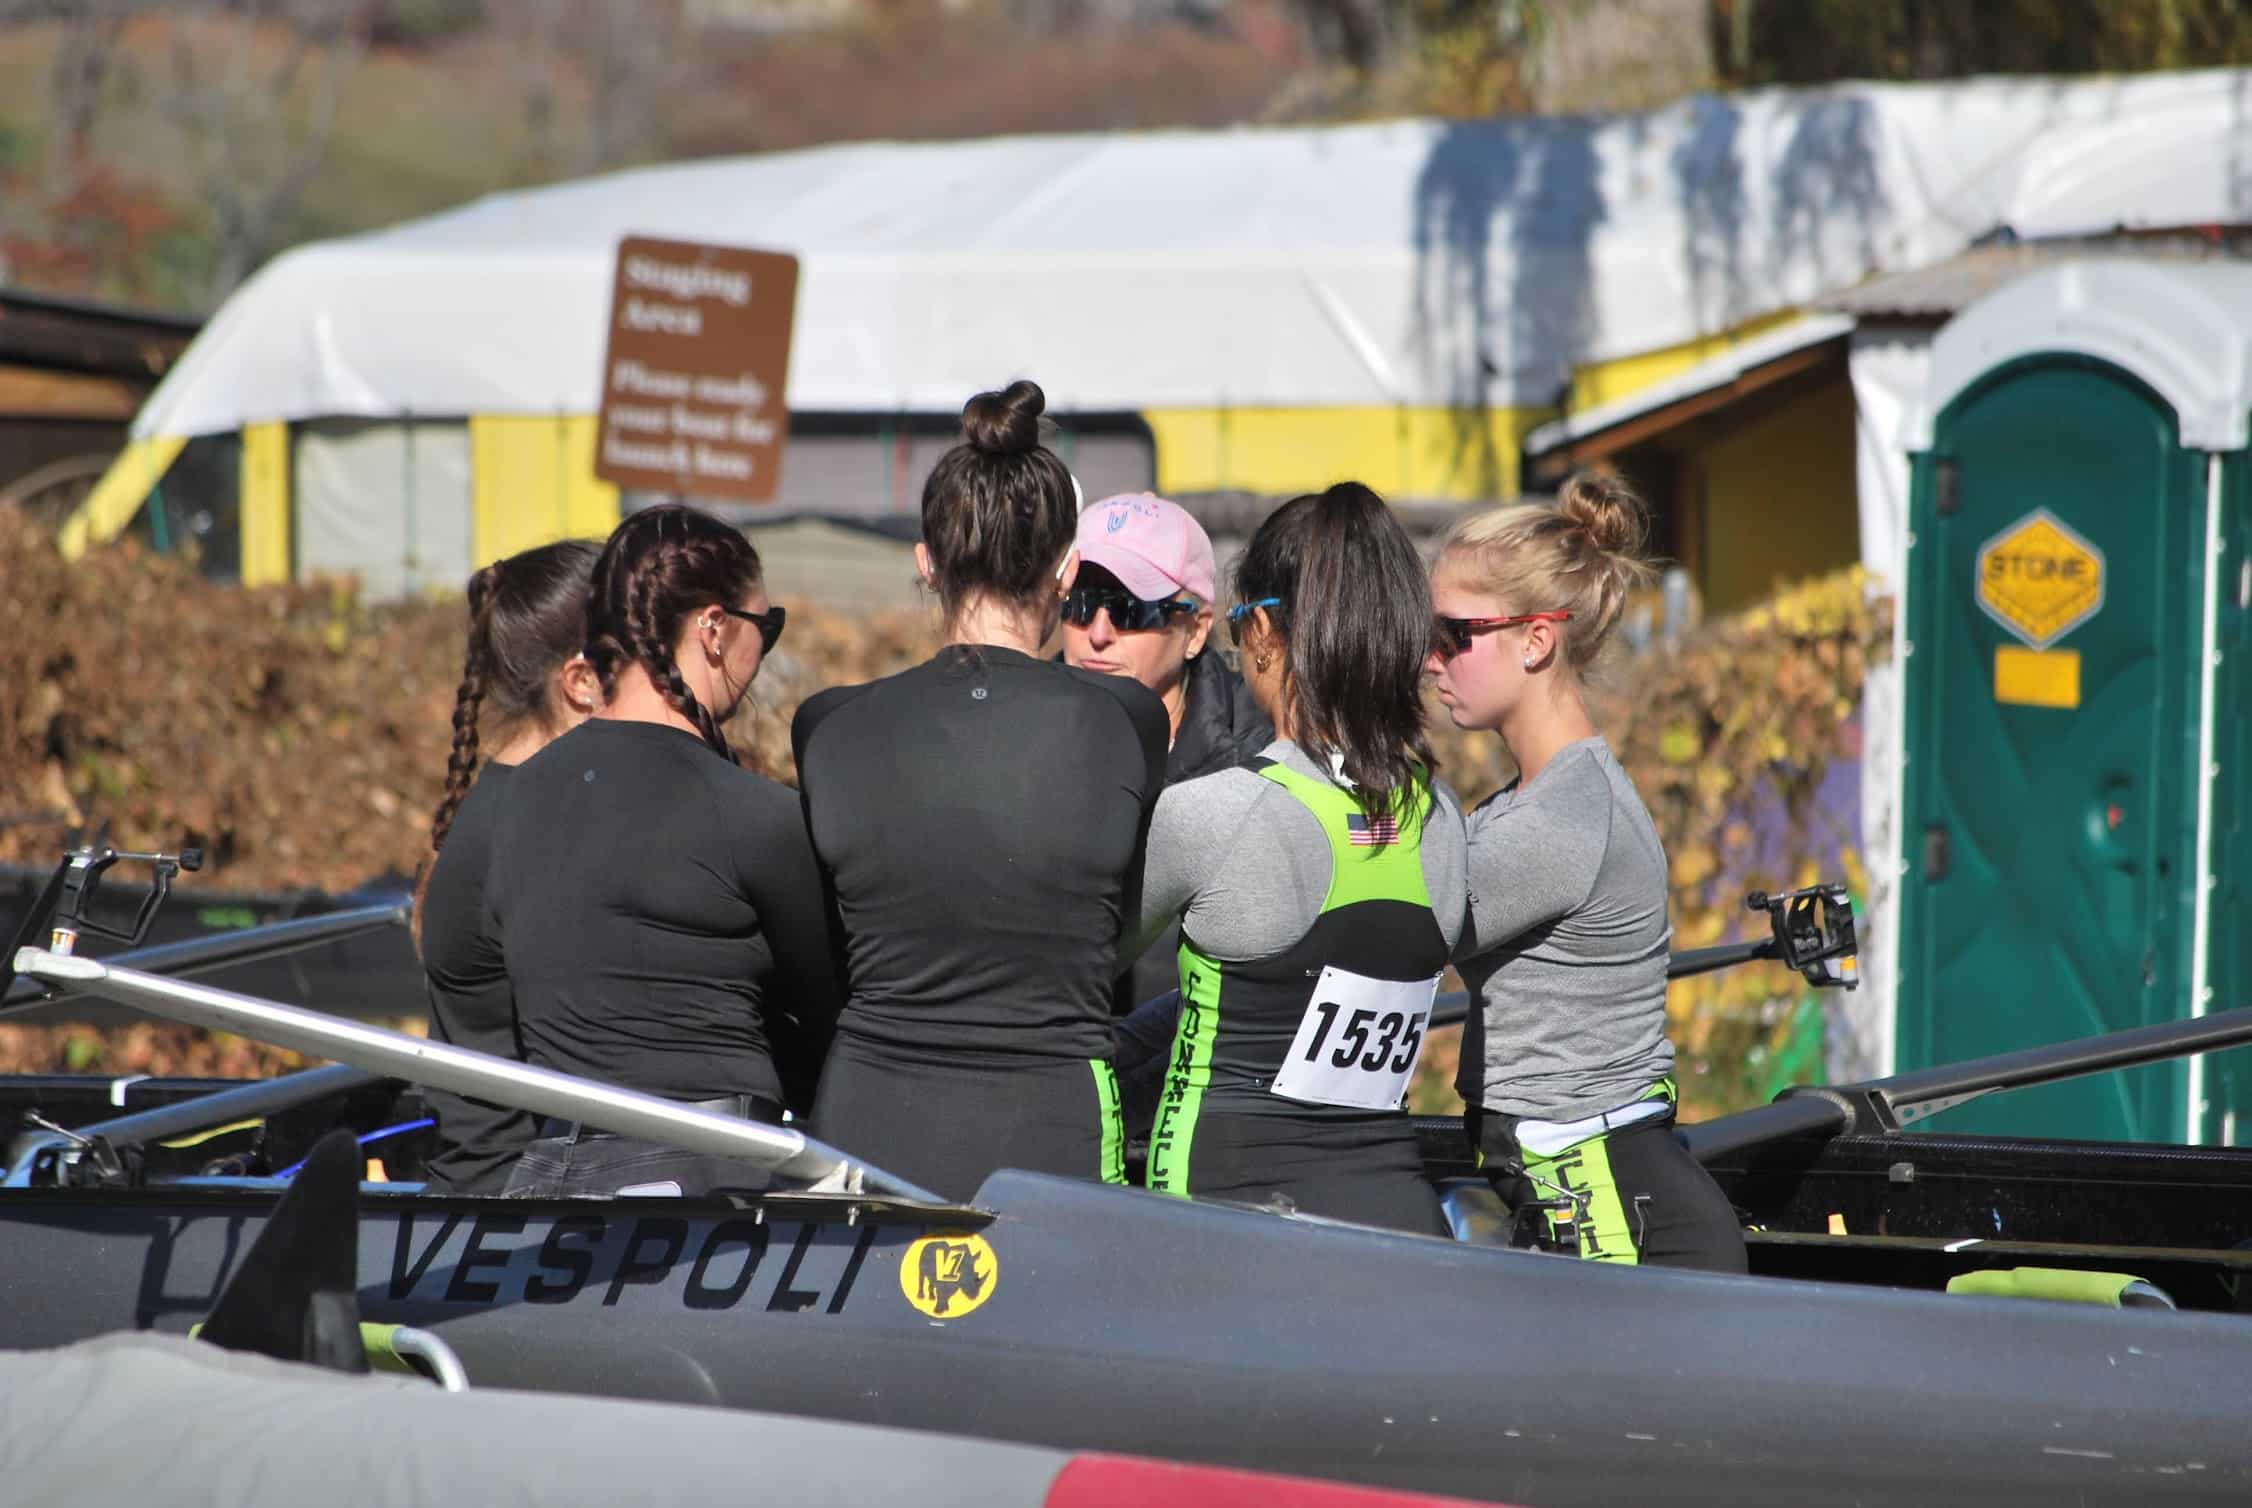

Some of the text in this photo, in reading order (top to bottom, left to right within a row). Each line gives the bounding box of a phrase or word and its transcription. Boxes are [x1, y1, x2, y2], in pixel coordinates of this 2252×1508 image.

[625, 257, 751, 305] Staging
[622, 297, 703, 336] Area
[612, 361, 690, 398] Please
[1988, 555, 2087, 581] STONE
[1304, 1001, 1428, 1074] 1535
[390, 1212, 876, 1314] VESPOLI
